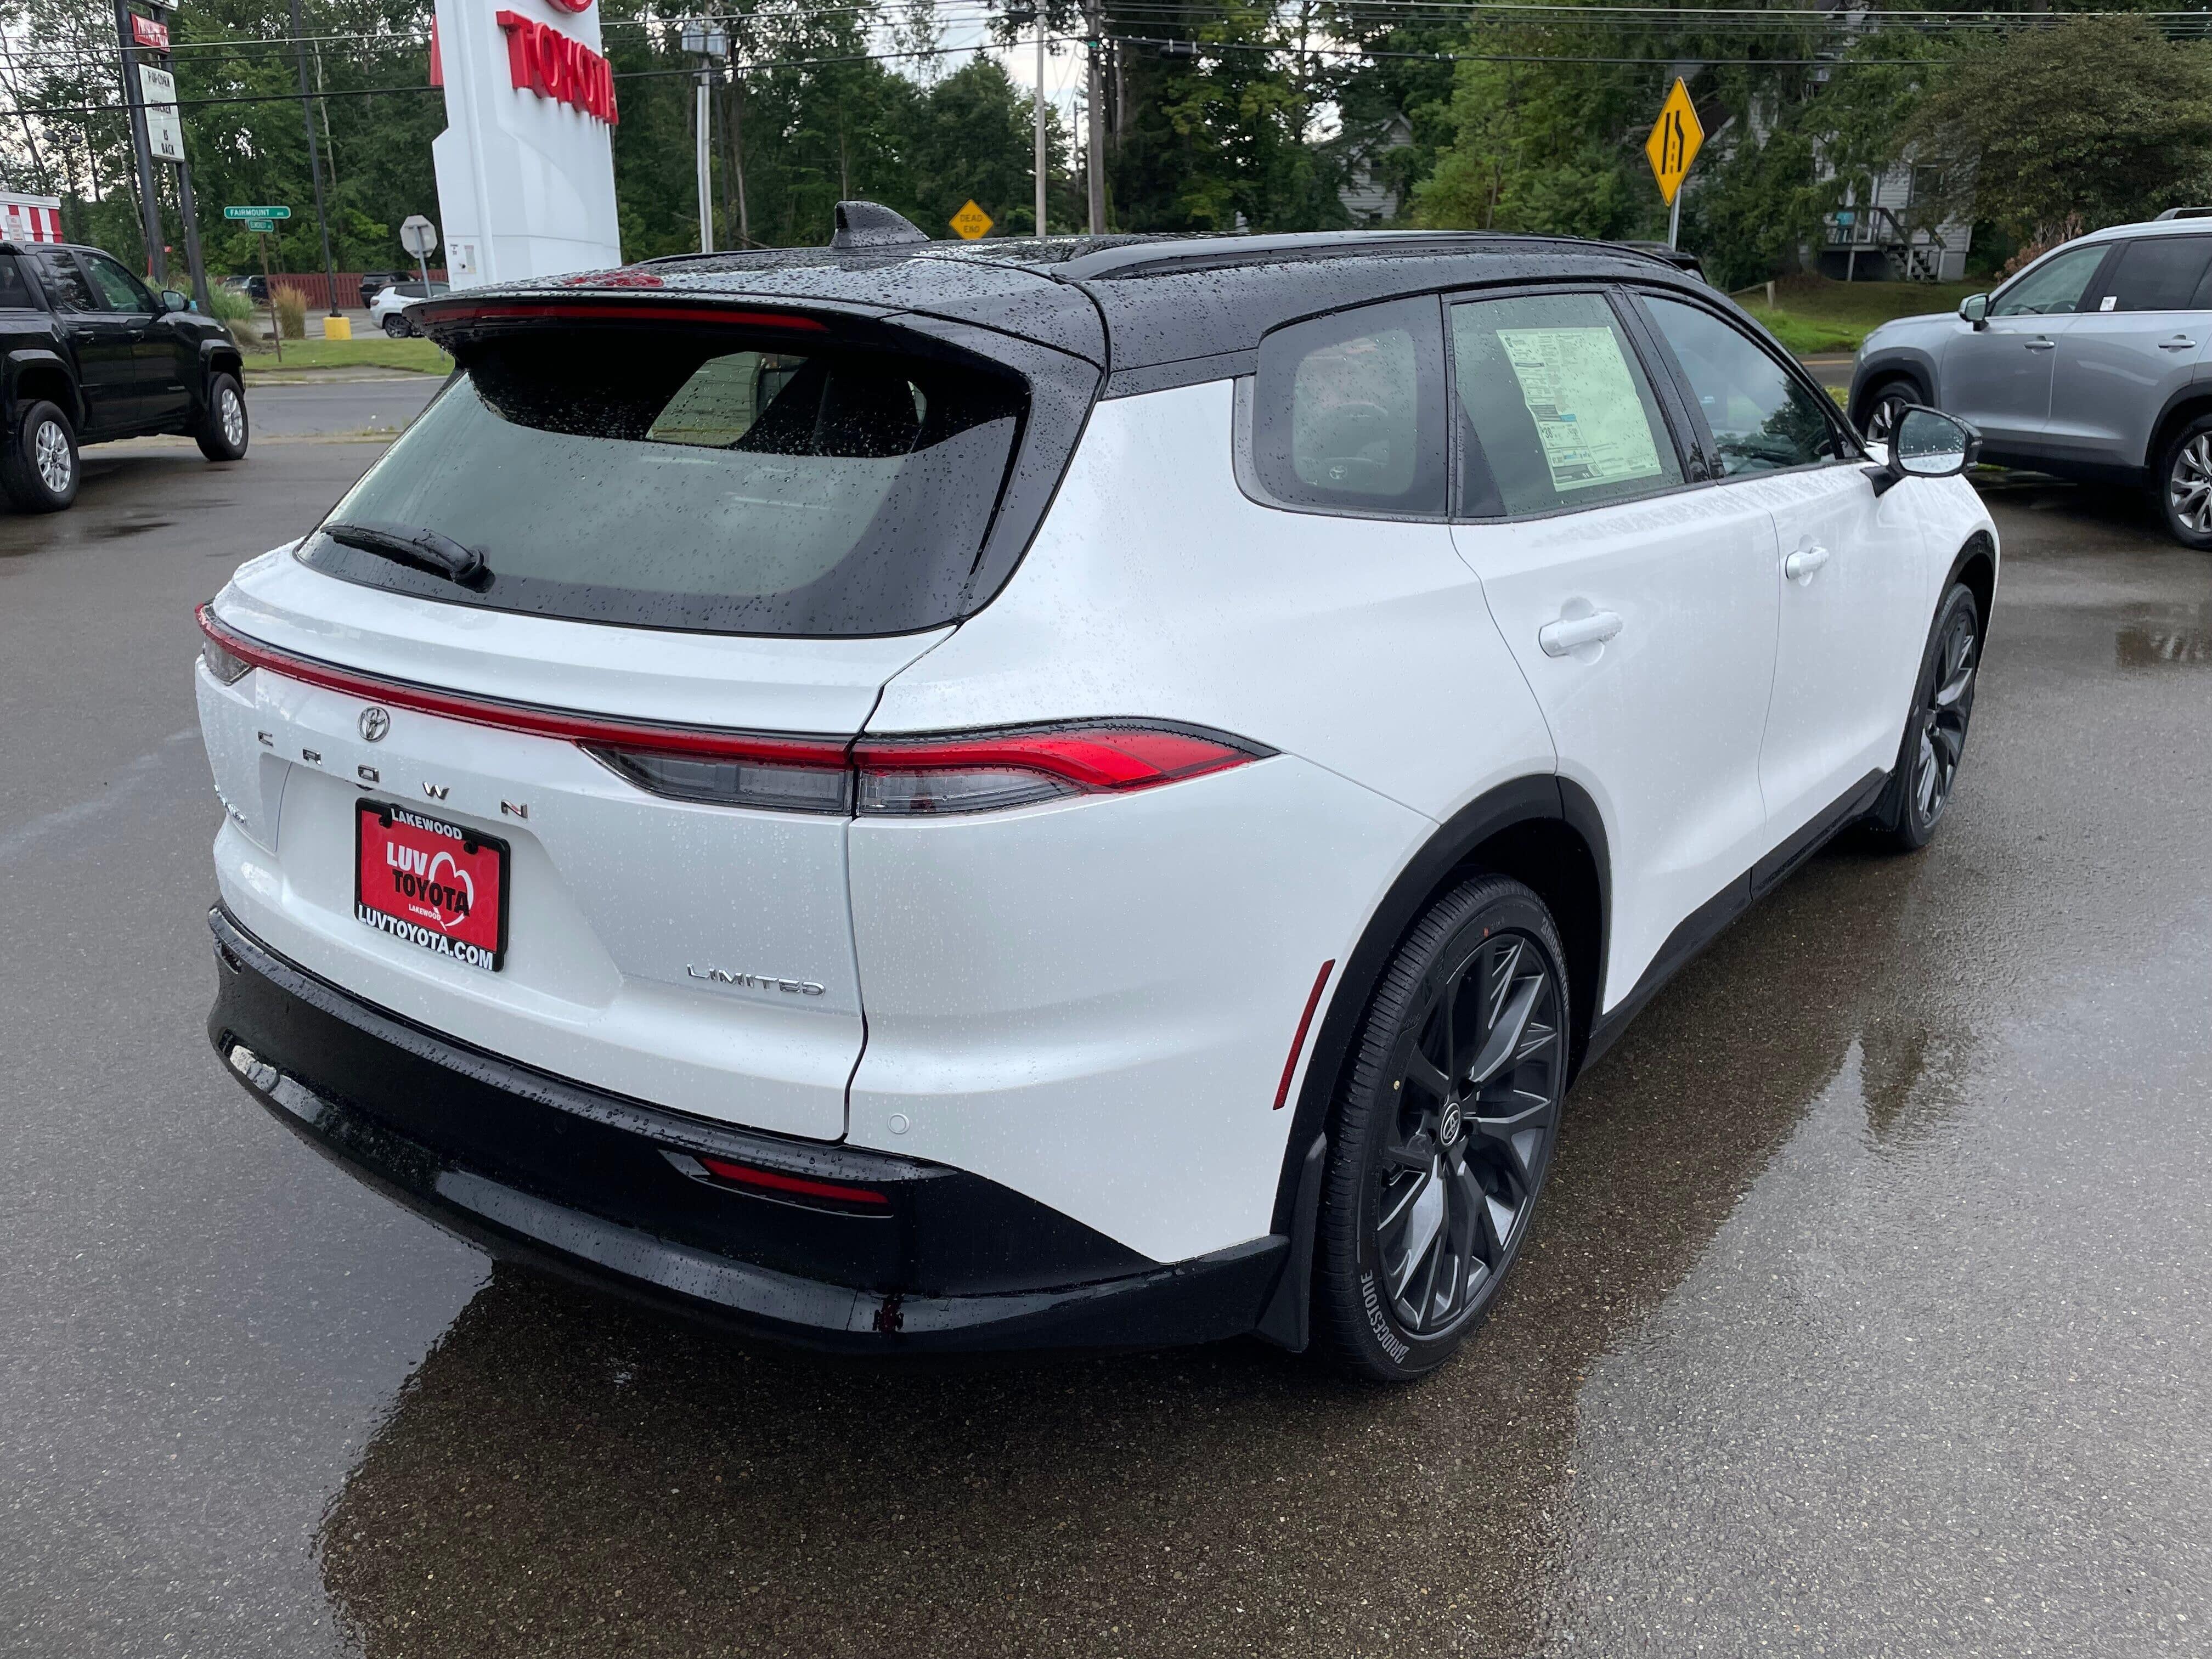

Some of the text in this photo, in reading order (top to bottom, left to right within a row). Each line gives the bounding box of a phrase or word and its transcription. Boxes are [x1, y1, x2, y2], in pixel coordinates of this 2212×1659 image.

[496, 10, 619, 125] TOYOTA
[257, 731, 528, 819] CROWN
[390, 808, 463, 840] LAKEWOOD
[387, 841, 428, 876] LUV
[392, 869, 470, 917] TOYOTA
[408, 904, 441, 921] LAKEWOOD
[358, 904, 493, 970] LUVTOYOTA.COM
[686, 963, 826, 995] LIMITED
[1361, 1269, 1410, 1364] BRIDGESTONE
